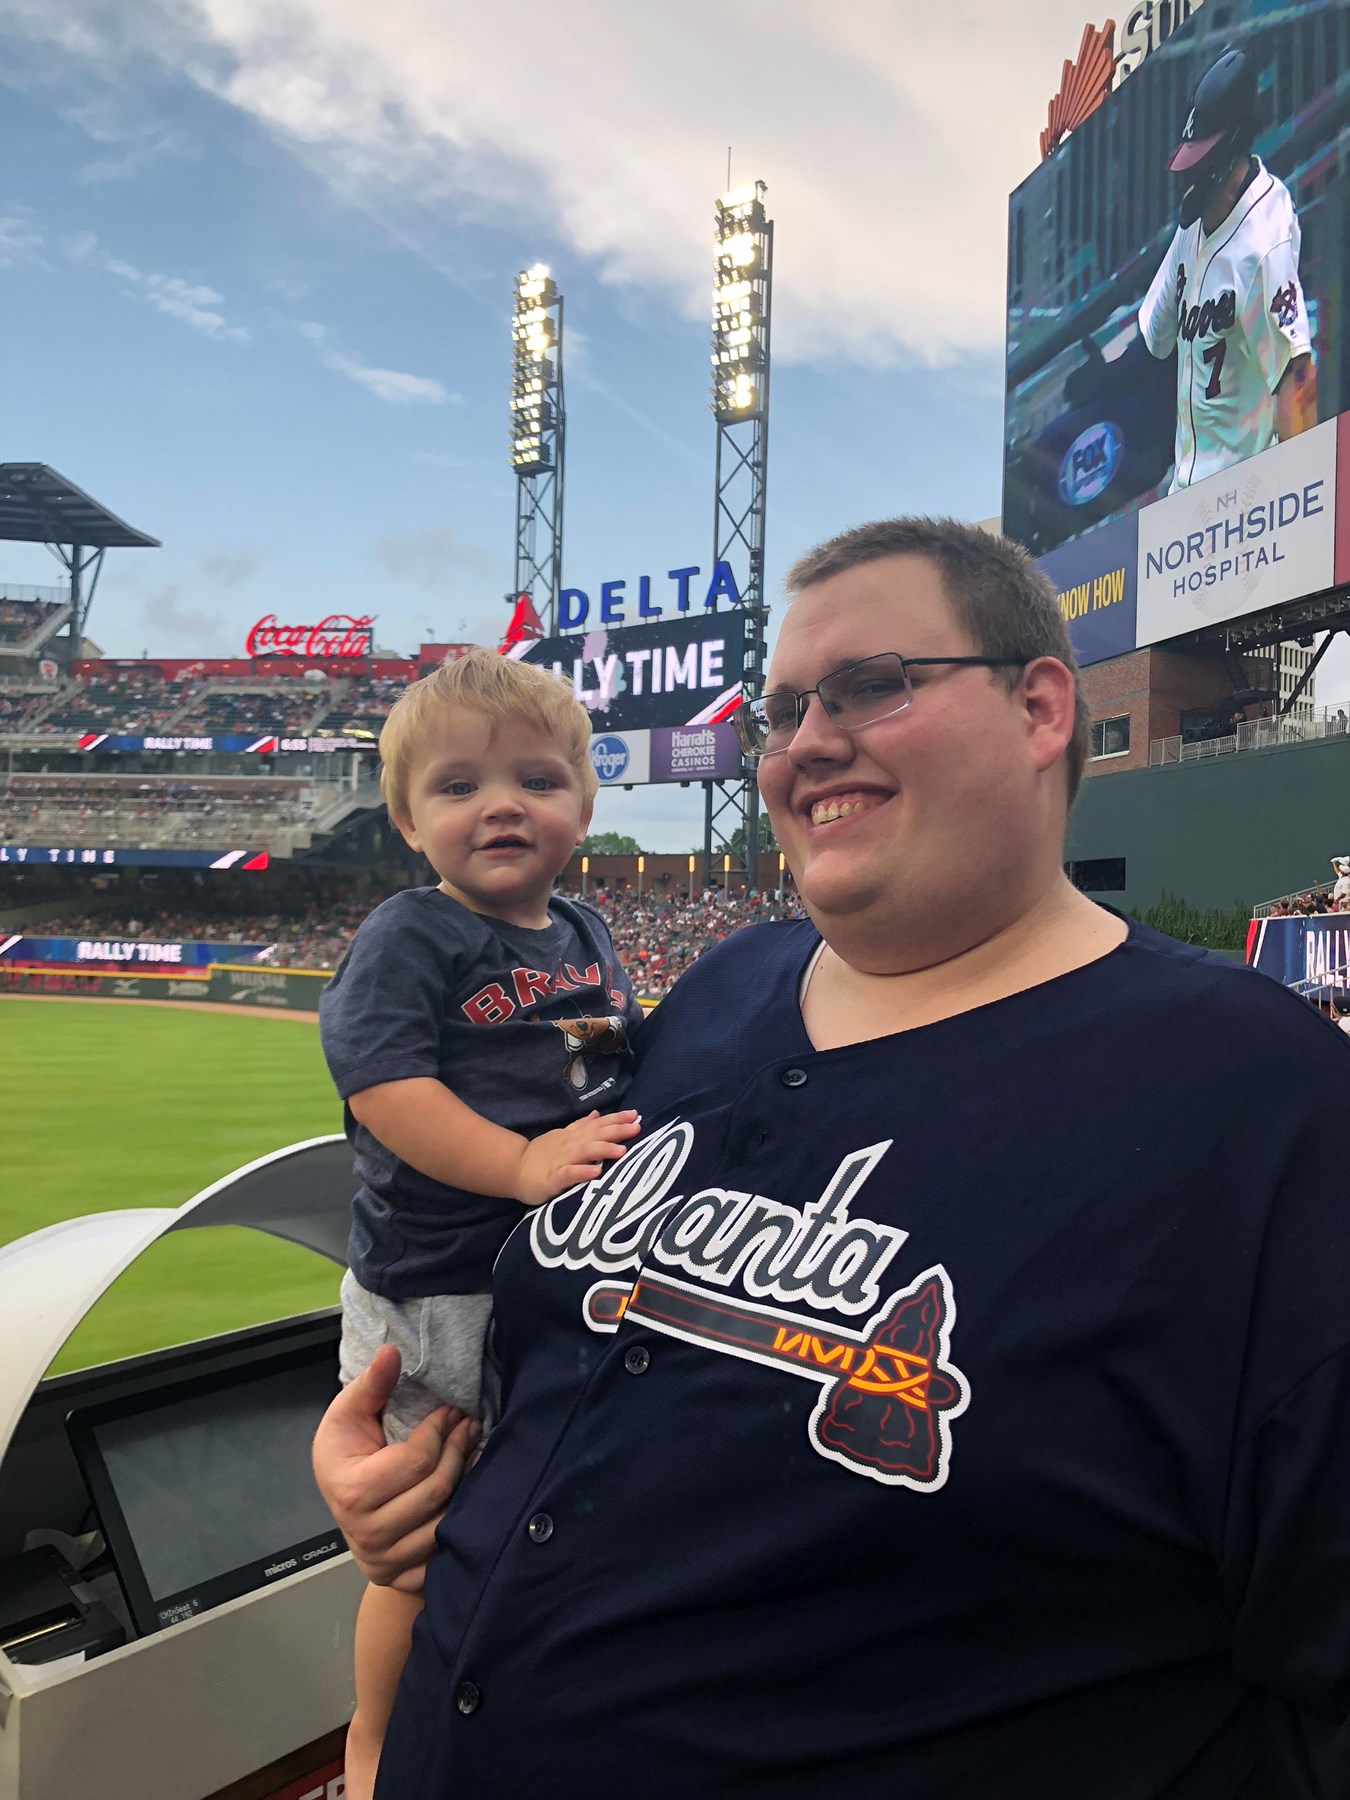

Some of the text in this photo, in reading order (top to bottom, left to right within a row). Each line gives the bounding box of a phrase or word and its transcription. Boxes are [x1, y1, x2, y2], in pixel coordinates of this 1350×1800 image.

[1202, 337, 1227, 400] 7
[1146, 480, 1325, 579] NORTHSIDE
[1173, 542, 1286, 598] HOSPITAL
[559, 560, 742, 629] DELTA
[1057, 567, 1126, 621] NOW HOW
[625, 639, 725, 696] TIME
[143, 736, 213, 750] RALLY TIME
[671, 729, 716, 748] Harrah's
[671, 745, 716, 758] CHEROKEE
[671, 756, 716, 768] CASINOS
[77, 941, 182, 963] RALLY TIME
[264, 1541, 338, 1577] micros ORACLE
